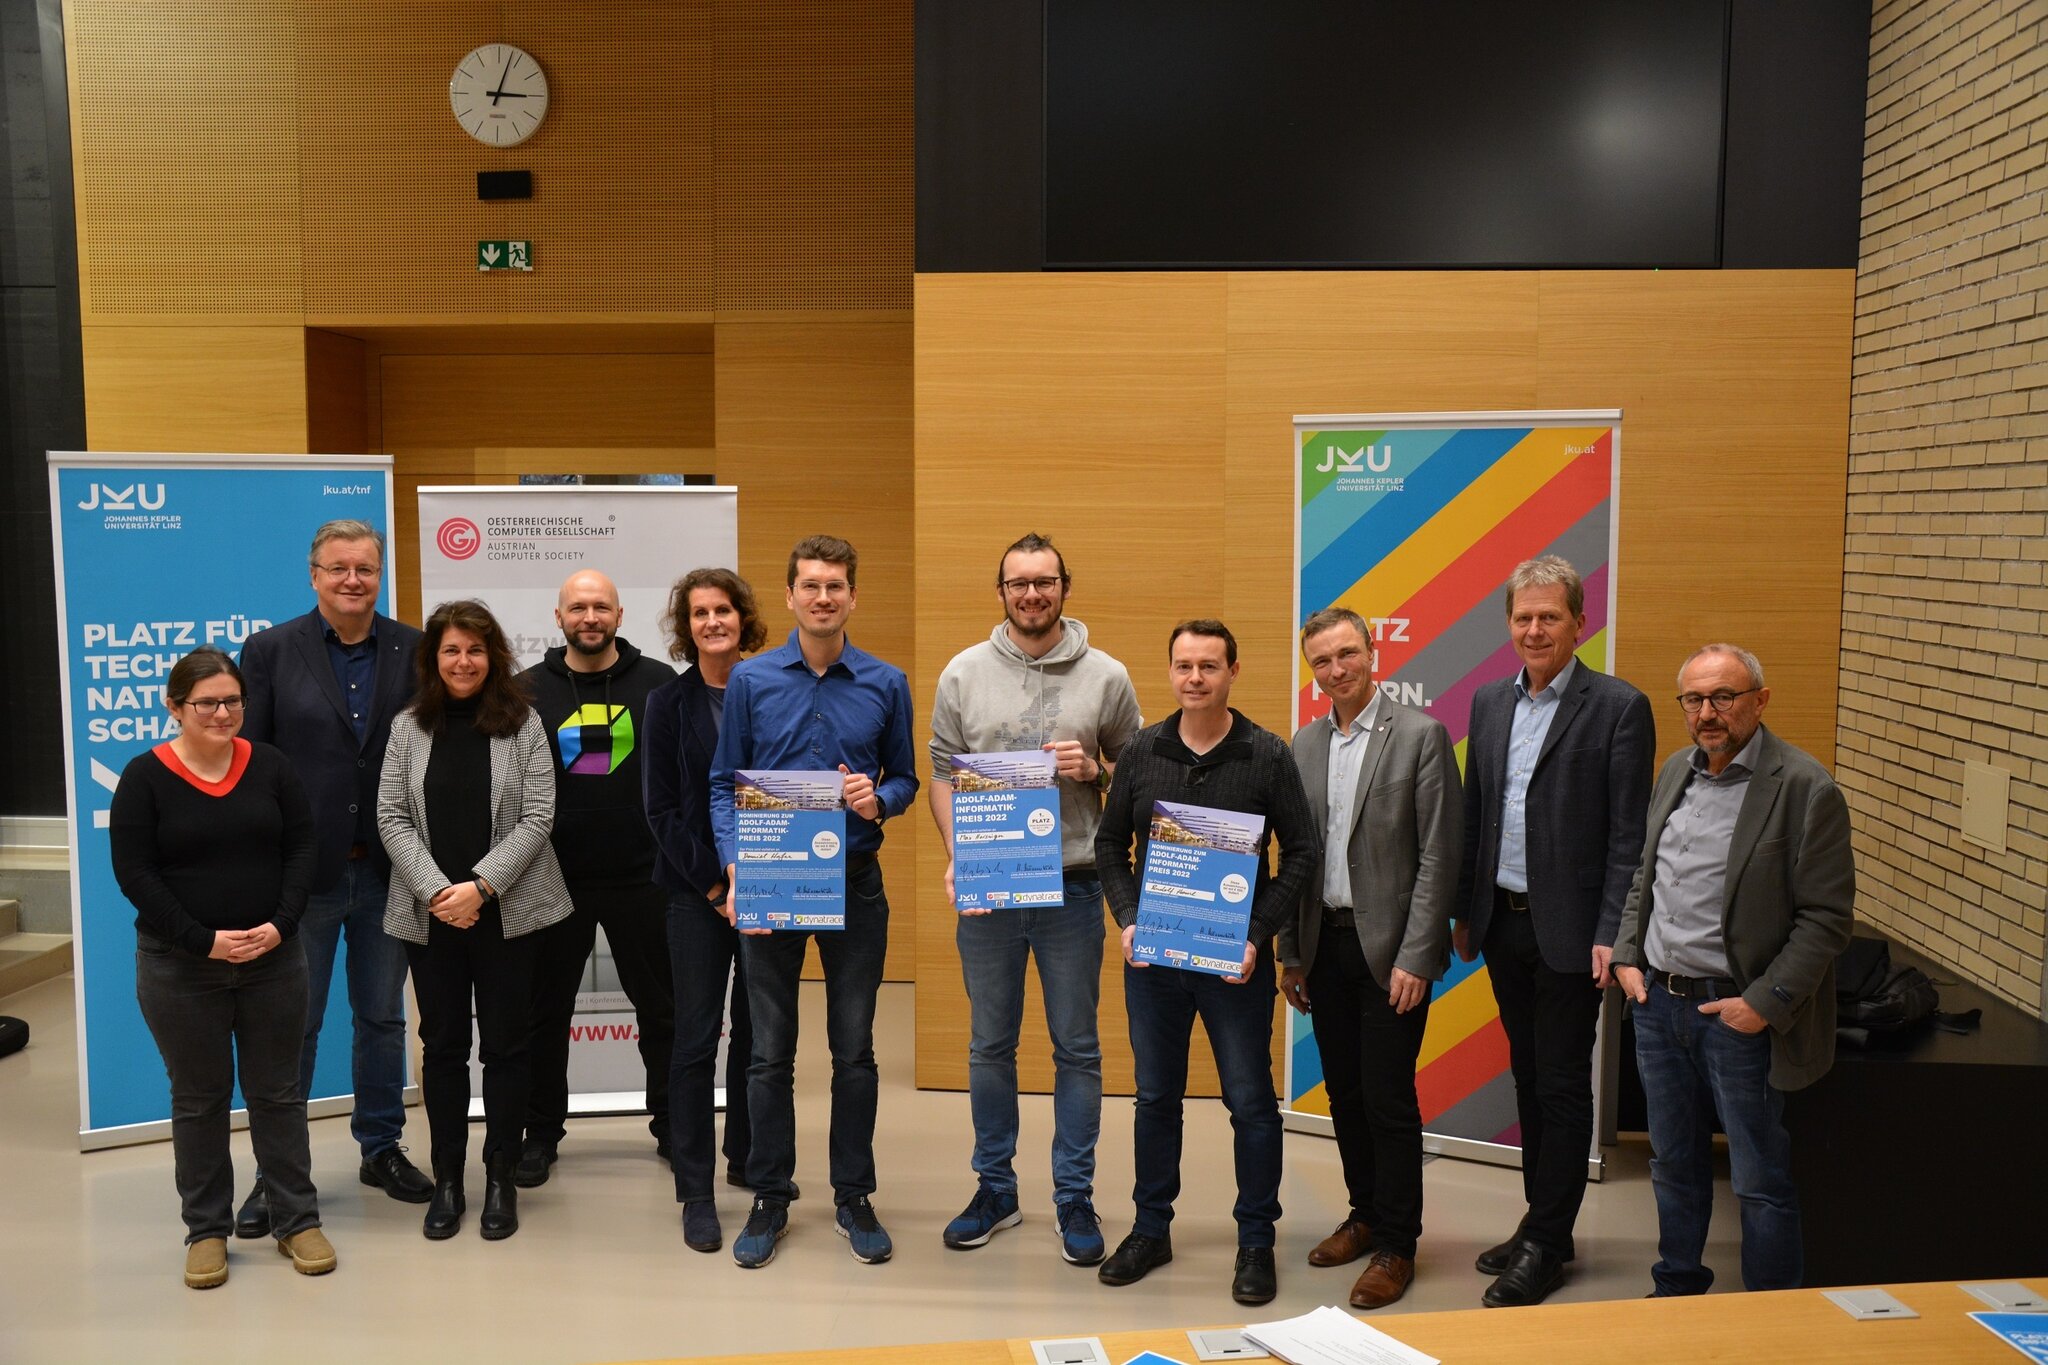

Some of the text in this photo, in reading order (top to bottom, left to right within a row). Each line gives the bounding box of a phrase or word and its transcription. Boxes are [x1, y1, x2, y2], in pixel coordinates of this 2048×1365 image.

[1564, 444, 1595, 455] jku.at
[1316, 445, 1391, 472] JKU
[1377, 477, 1404, 485] KEPLER
[323, 485, 371, 496] jku.at/tnf
[78, 483, 166, 510] JKU
[104, 515, 181, 523] JOHANNES KEPLER
[488, 517, 583, 526] OESTERREICHISCHE
[104, 521, 160, 530] UNIVERSITÄT
[488, 527, 616, 536] COMPUTER GESELLSCHAFT
[488, 542, 536, 550] AUSTRIAN
[488, 552, 585, 561] COMPUTER SOCIETY
[84, 622, 195, 647] PLATZ
[88, 715, 183, 742] SCHA
[955, 794, 1017, 804] ADOLF-ADAM-
[955, 804, 1016, 813] INFORMATIK-
[956, 814, 1007, 823] PREIS 2022
[1151, 844, 1192, 854] NOMINIERUNG
[1150, 850, 1201, 863] ADOLF-ADAM-
[1149, 858, 1199, 870] INFORMATIK-
[1148, 866, 1190, 878] PREIS 2022
[958, 893, 977, 902] JKU
[1021, 893, 1062, 902] dynatrace
[737, 912, 758, 920] JKU
[804, 916, 843, 924] dynatrace
[1135, 945, 1156, 954] JKU
[1201, 959, 1240, 971] dynatrace
